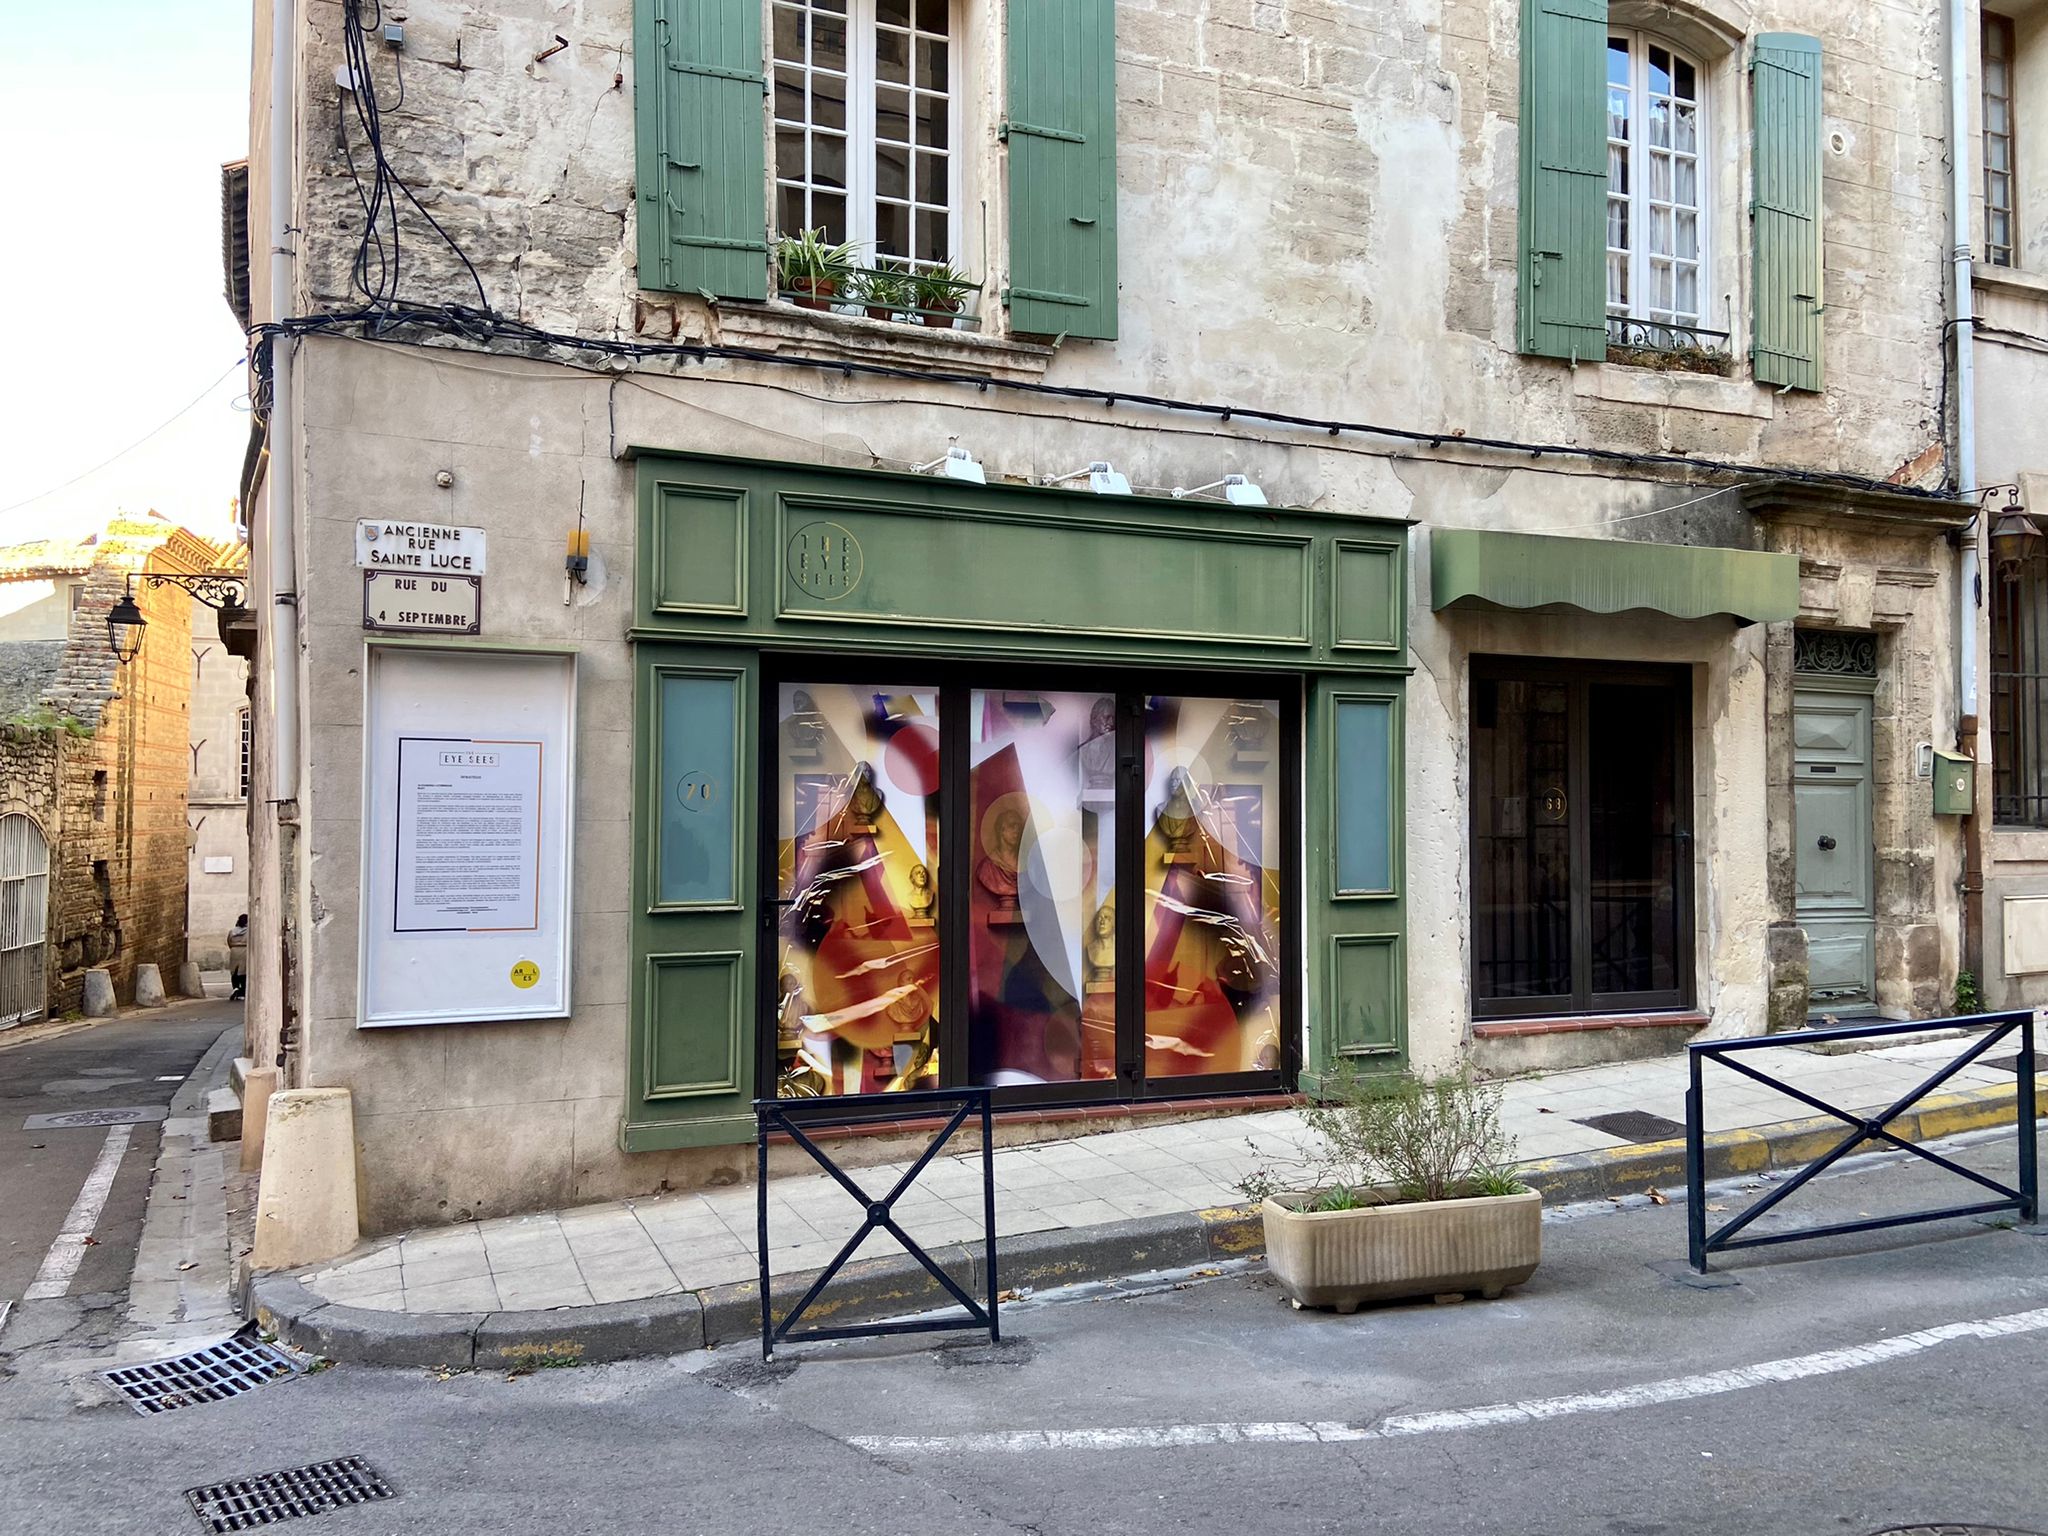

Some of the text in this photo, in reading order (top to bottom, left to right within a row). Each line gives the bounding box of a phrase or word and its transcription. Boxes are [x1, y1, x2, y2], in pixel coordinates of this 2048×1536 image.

[384, 525, 461, 540] ANCIENNE
[408, 538, 436, 550] RUE
[801, 534, 849, 552] THE
[371, 550, 471, 570] SAINTE LUCE
[801, 553, 849, 571] EYE
[395, 578, 447, 592] RUE DU
[801, 573, 849, 586] SEES
[379, 610, 466, 626] 4 SEPTEMBRE
[444, 755, 494, 764] EYE SEES
[687, 783, 710, 800] 70
